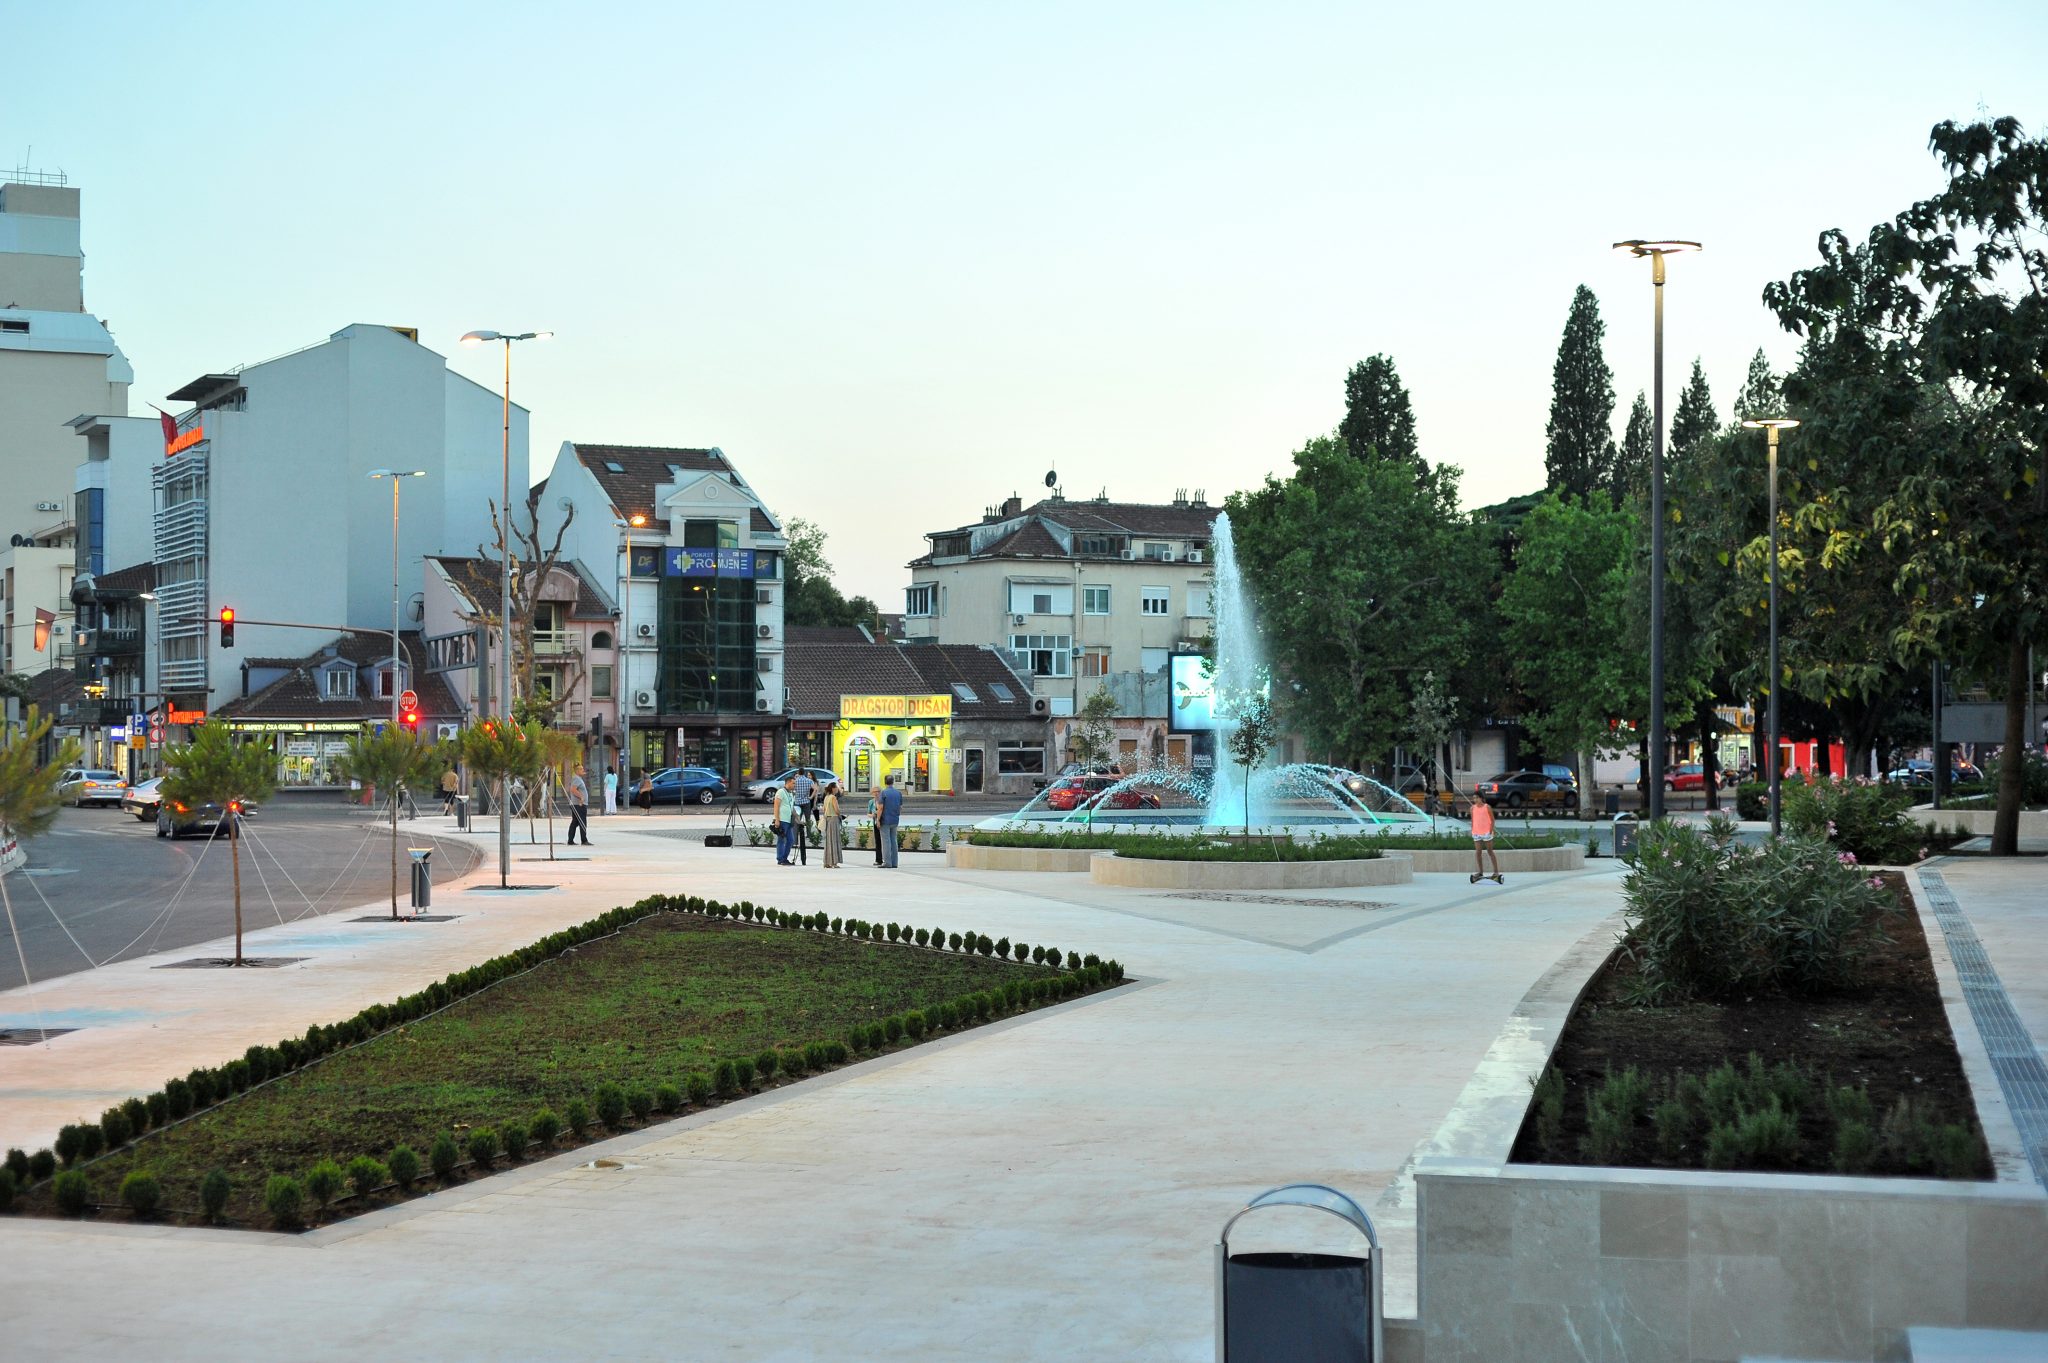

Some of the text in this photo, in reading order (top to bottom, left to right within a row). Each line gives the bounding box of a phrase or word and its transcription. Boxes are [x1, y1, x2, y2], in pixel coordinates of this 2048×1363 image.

[637, 555, 654, 567] DF
[401, 696, 416, 705] STOP
[843, 698, 904, 715] DRAGSTOR
[134, 713, 143, 726] P
